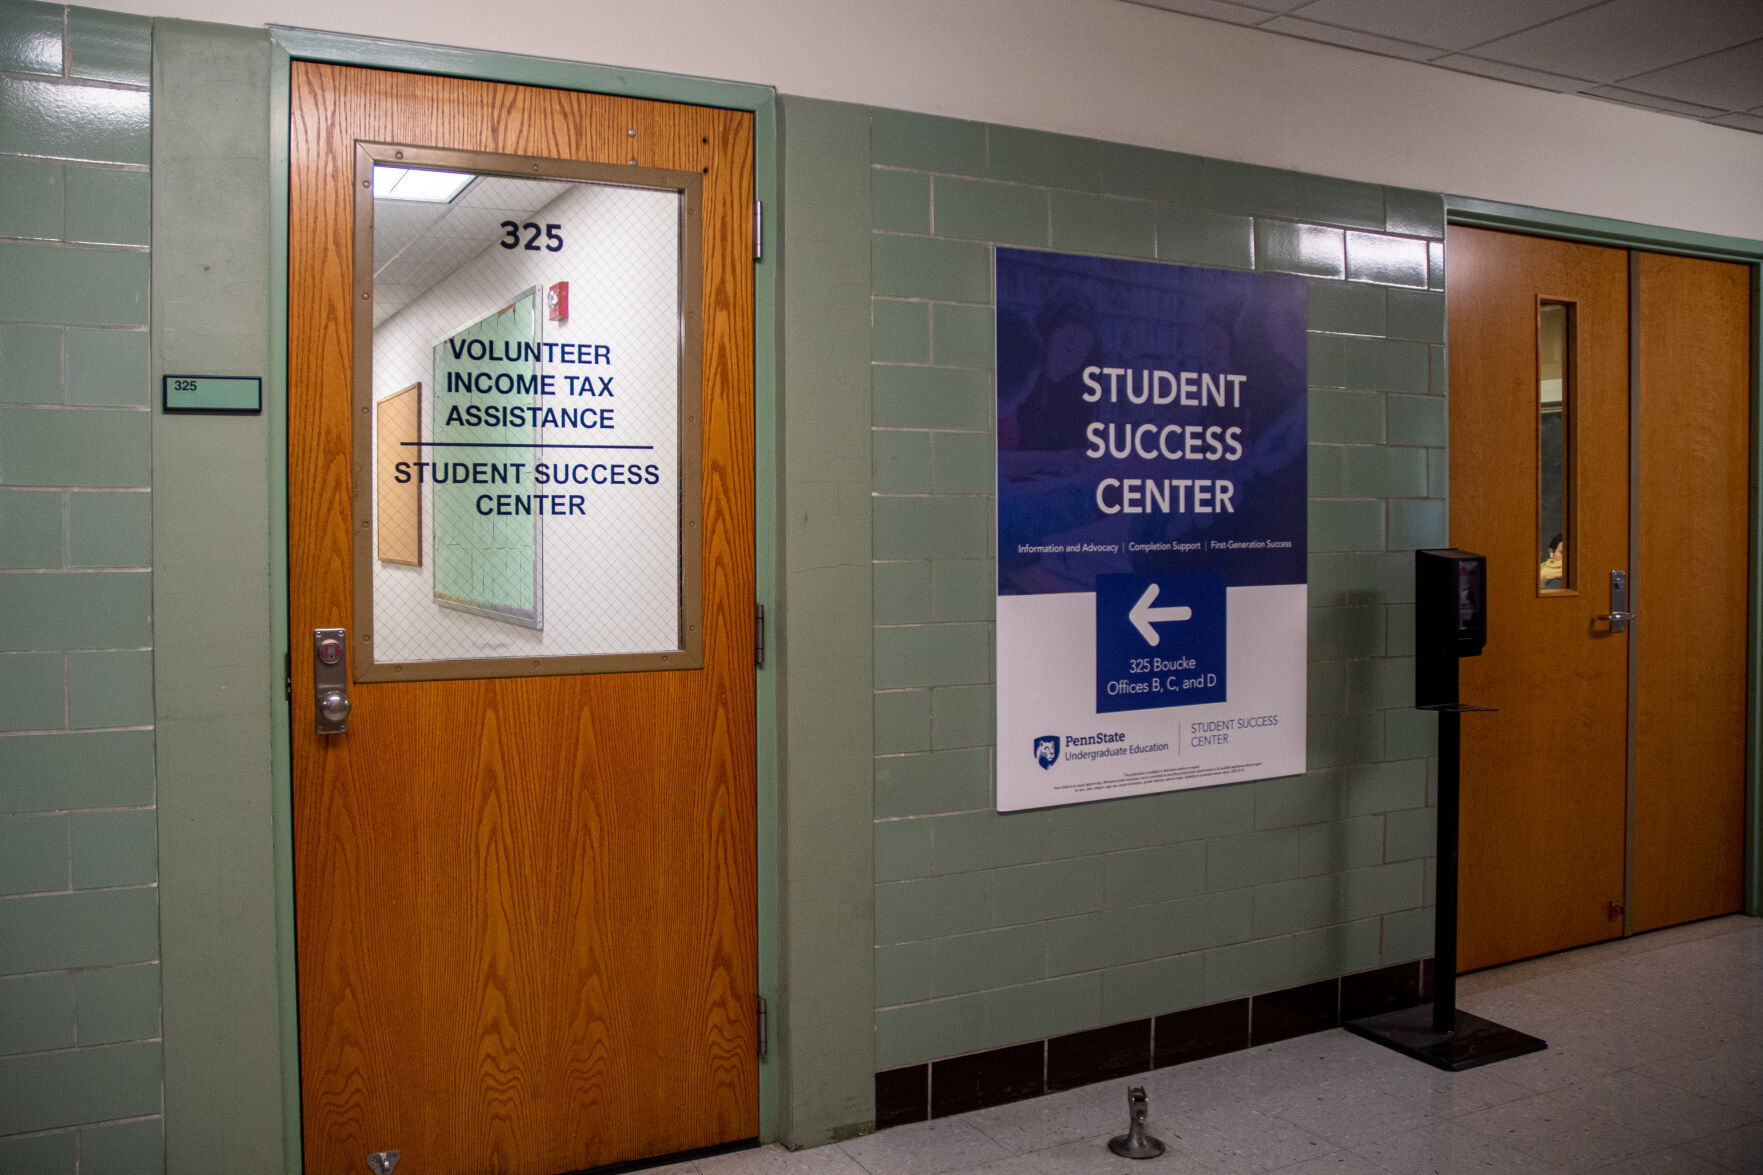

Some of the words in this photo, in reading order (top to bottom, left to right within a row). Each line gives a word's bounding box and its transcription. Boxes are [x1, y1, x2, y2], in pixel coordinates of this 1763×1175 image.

[499, 220, 565, 253] 325
[448, 338, 612, 366] VOLUNTEER
[174, 379, 198, 392] 325
[446, 371, 556, 396] INCOME
[563, 375, 615, 398] TAX
[1082, 365, 1247, 408] STUDENT
[445, 404, 615, 429] ASSISTANCE
[1086, 421, 1243, 461] SUCCESS
[394, 462, 526, 485] STUDENT
[534, 463, 660, 486] SUCCESS
[475, 493, 586, 517] CENTER
[1096, 477, 1235, 515] CENTER
[1018, 543, 1064, 553] Information
[1065, 543, 1081, 553] and
[1082, 542, 1119, 554] Advocacy
[1128, 541, 1171, 553] Completion
[1172, 541, 1201, 552] Support
[1210, 540, 1265, 550] First-Generation
[1266, 539, 1292, 549] Success
[1129, 658, 1151, 674] 325
[1153, 655, 1197, 673] Boucke
[1107, 680, 1150, 697] Offices
[1152, 678, 1165, 694] B,
[1166, 676, 1180, 692] C,
[1182, 673, 1205, 690] and
[1206, 673, 1217, 688] D
[1190, 719, 1236, 734] STUDENT
[1236, 714, 1279, 730] SUCCESS
[1065, 731, 1126, 748] PennState
[1065, 746, 1128, 762] Undergraduate
[1128, 741, 1169, 756] Education
[1190, 733, 1229, 748] CENTER
